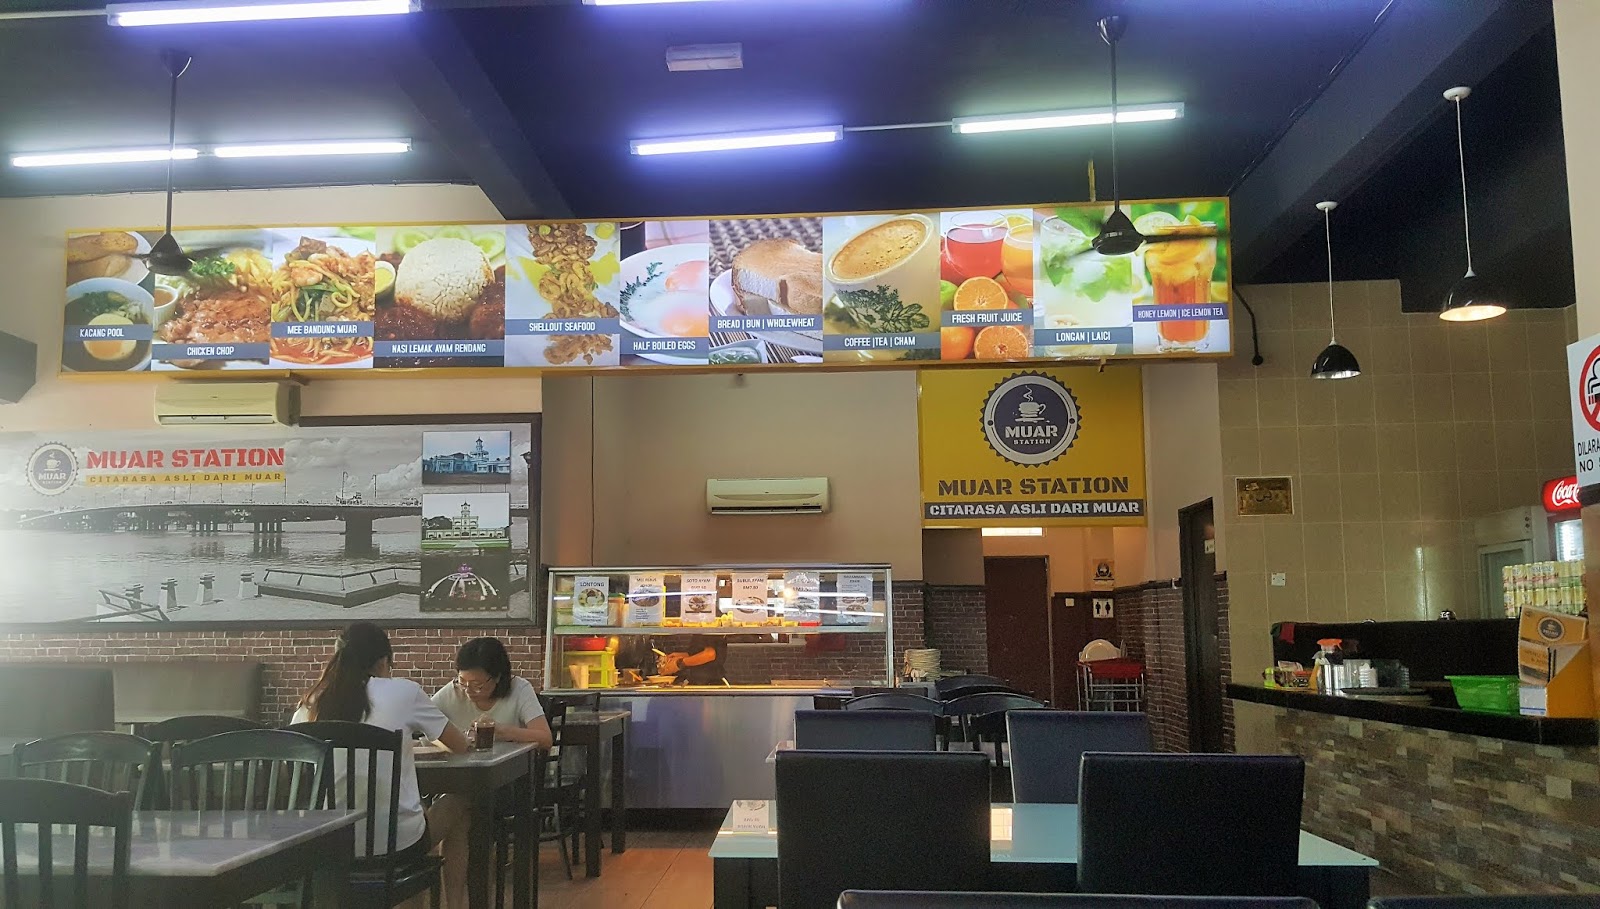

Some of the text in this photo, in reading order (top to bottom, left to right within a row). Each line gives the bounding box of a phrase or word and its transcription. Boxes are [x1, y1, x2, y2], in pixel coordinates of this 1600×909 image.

[952, 312, 1022, 324] FRESH FRUIT JUICE
[1138, 310, 1156, 318] HONEY
[1157, 310, 1177, 318] LEMON
[1182, 309, 1190, 317] ICE
[1192, 308, 1212, 316] LEMON
[1212, 308, 1224, 316] TEA
[528, 322, 596, 332] SHELLOUT SEAFOOD
[717, 320, 740, 329] BREAD
[746, 319, 760, 328] BUN
[766, 318, 815, 328] WHOLEWHEAT
[80, 328, 124, 337] KACANG POOL
[287, 324, 358, 334] MEE BANDUNG MUAR
[1056, 332, 1085, 341] LONGAN
[1092, 331, 1111, 341] LAICI
[633, 340, 696, 351] HALF BOILED EGGS
[844, 338, 871, 347] COFFEE
[894, 337, 916, 346] CHAM
[186, 346, 234, 356] CHICKEN CHOP
[392, 343, 486, 354] NASI LEMAK AYAM RENDANG
[1005, 425, 1058, 438] MUAR
[86, 448, 285, 469] MUAR STATION
[1579, 458, 1594, 473] NO
[38, 472, 66, 480] MUAR
[90, 475, 157, 483] CITARASA
[164, 474, 196, 482] ASLI
[938, 476, 1128, 496] MUAR STATION
[930, 501, 1140, 516] CITARASA ASLI DARI MUAR
